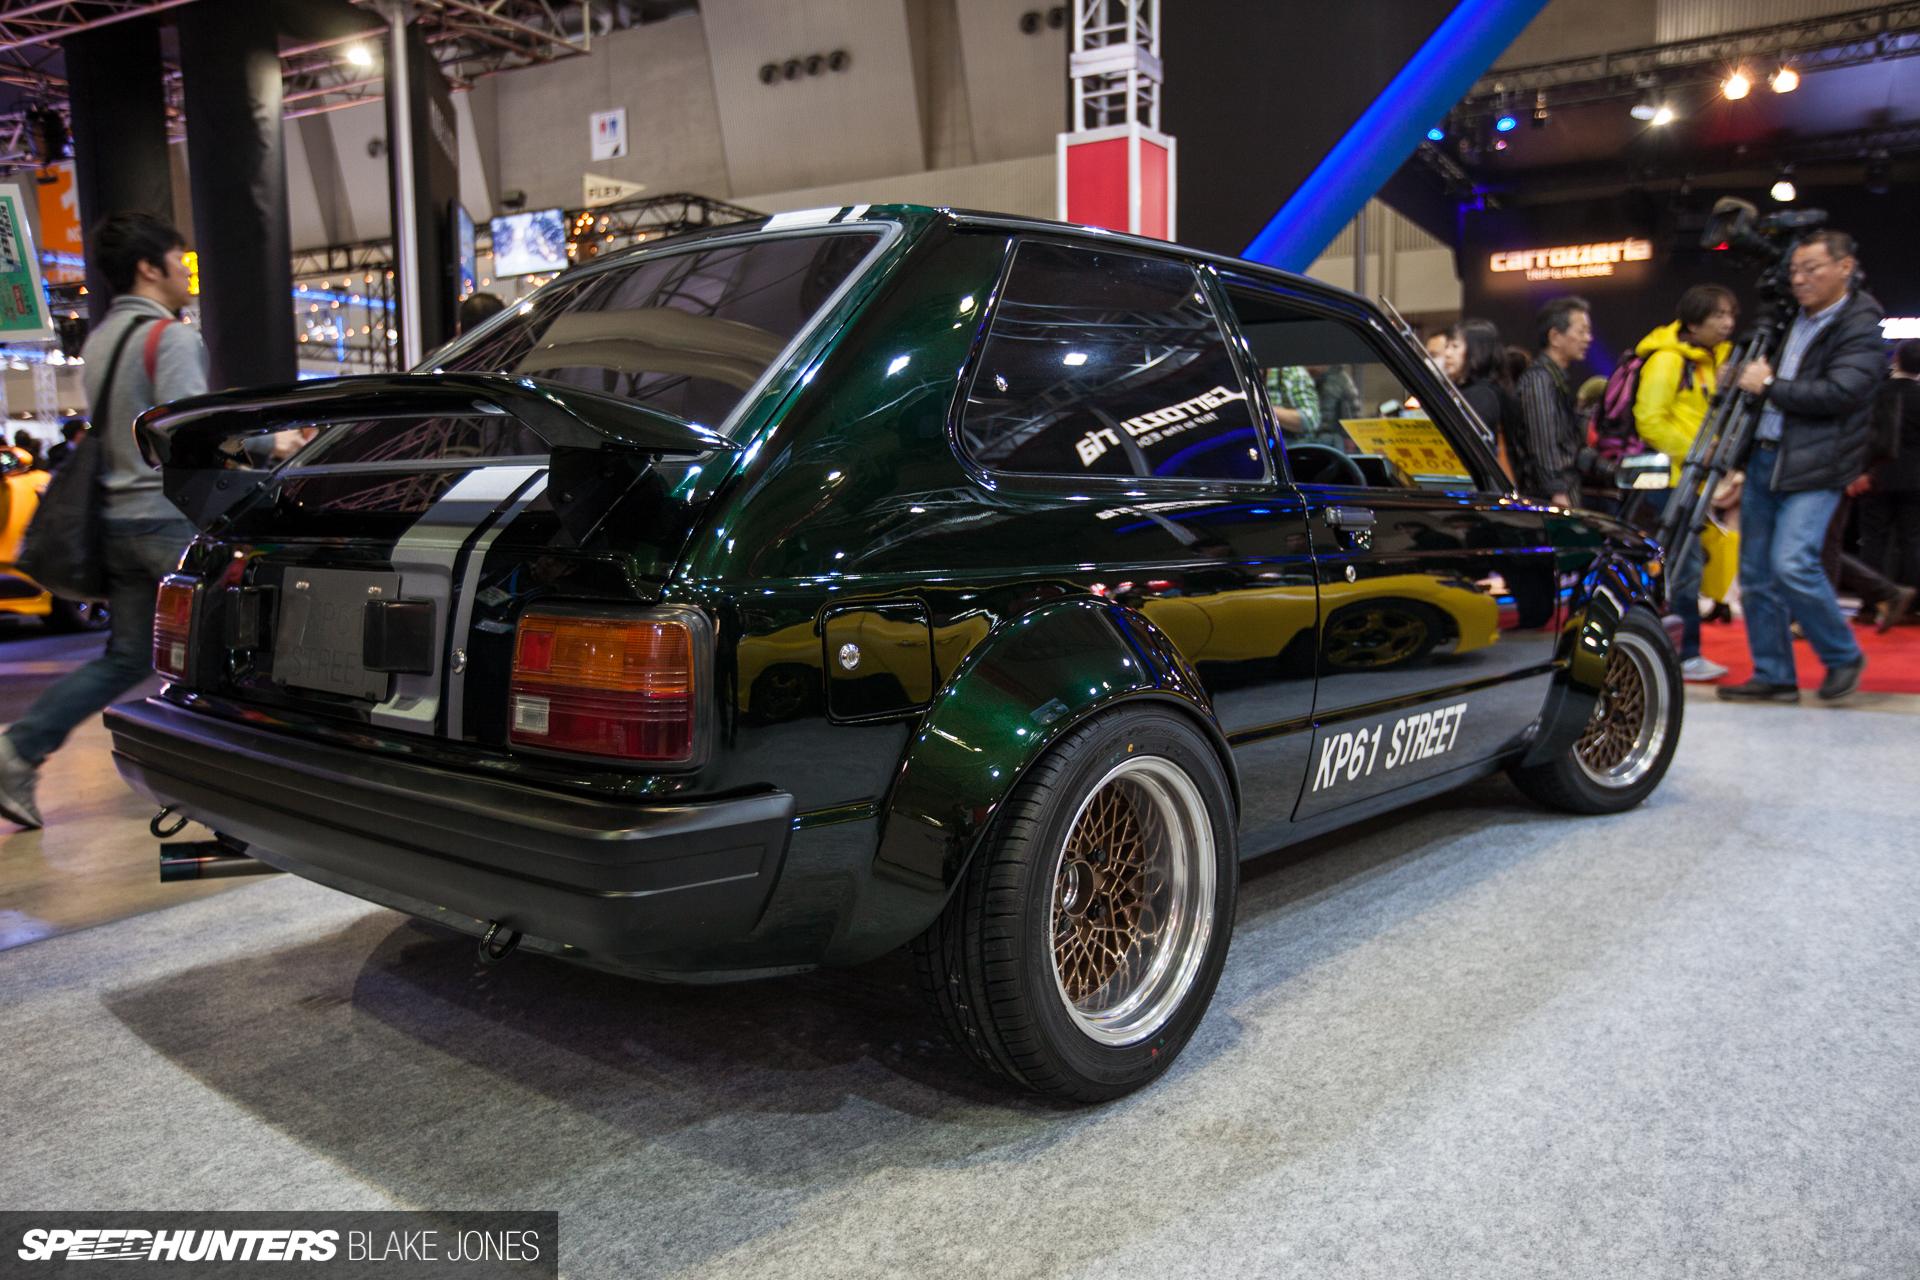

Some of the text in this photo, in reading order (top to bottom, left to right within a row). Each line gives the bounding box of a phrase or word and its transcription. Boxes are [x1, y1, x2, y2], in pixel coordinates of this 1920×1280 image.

[588, 185, 622, 199] FLEX
[1491, 237, 1652, 272] carrozzeria
[1312, 702, 1468, 792] KP61 STREET
